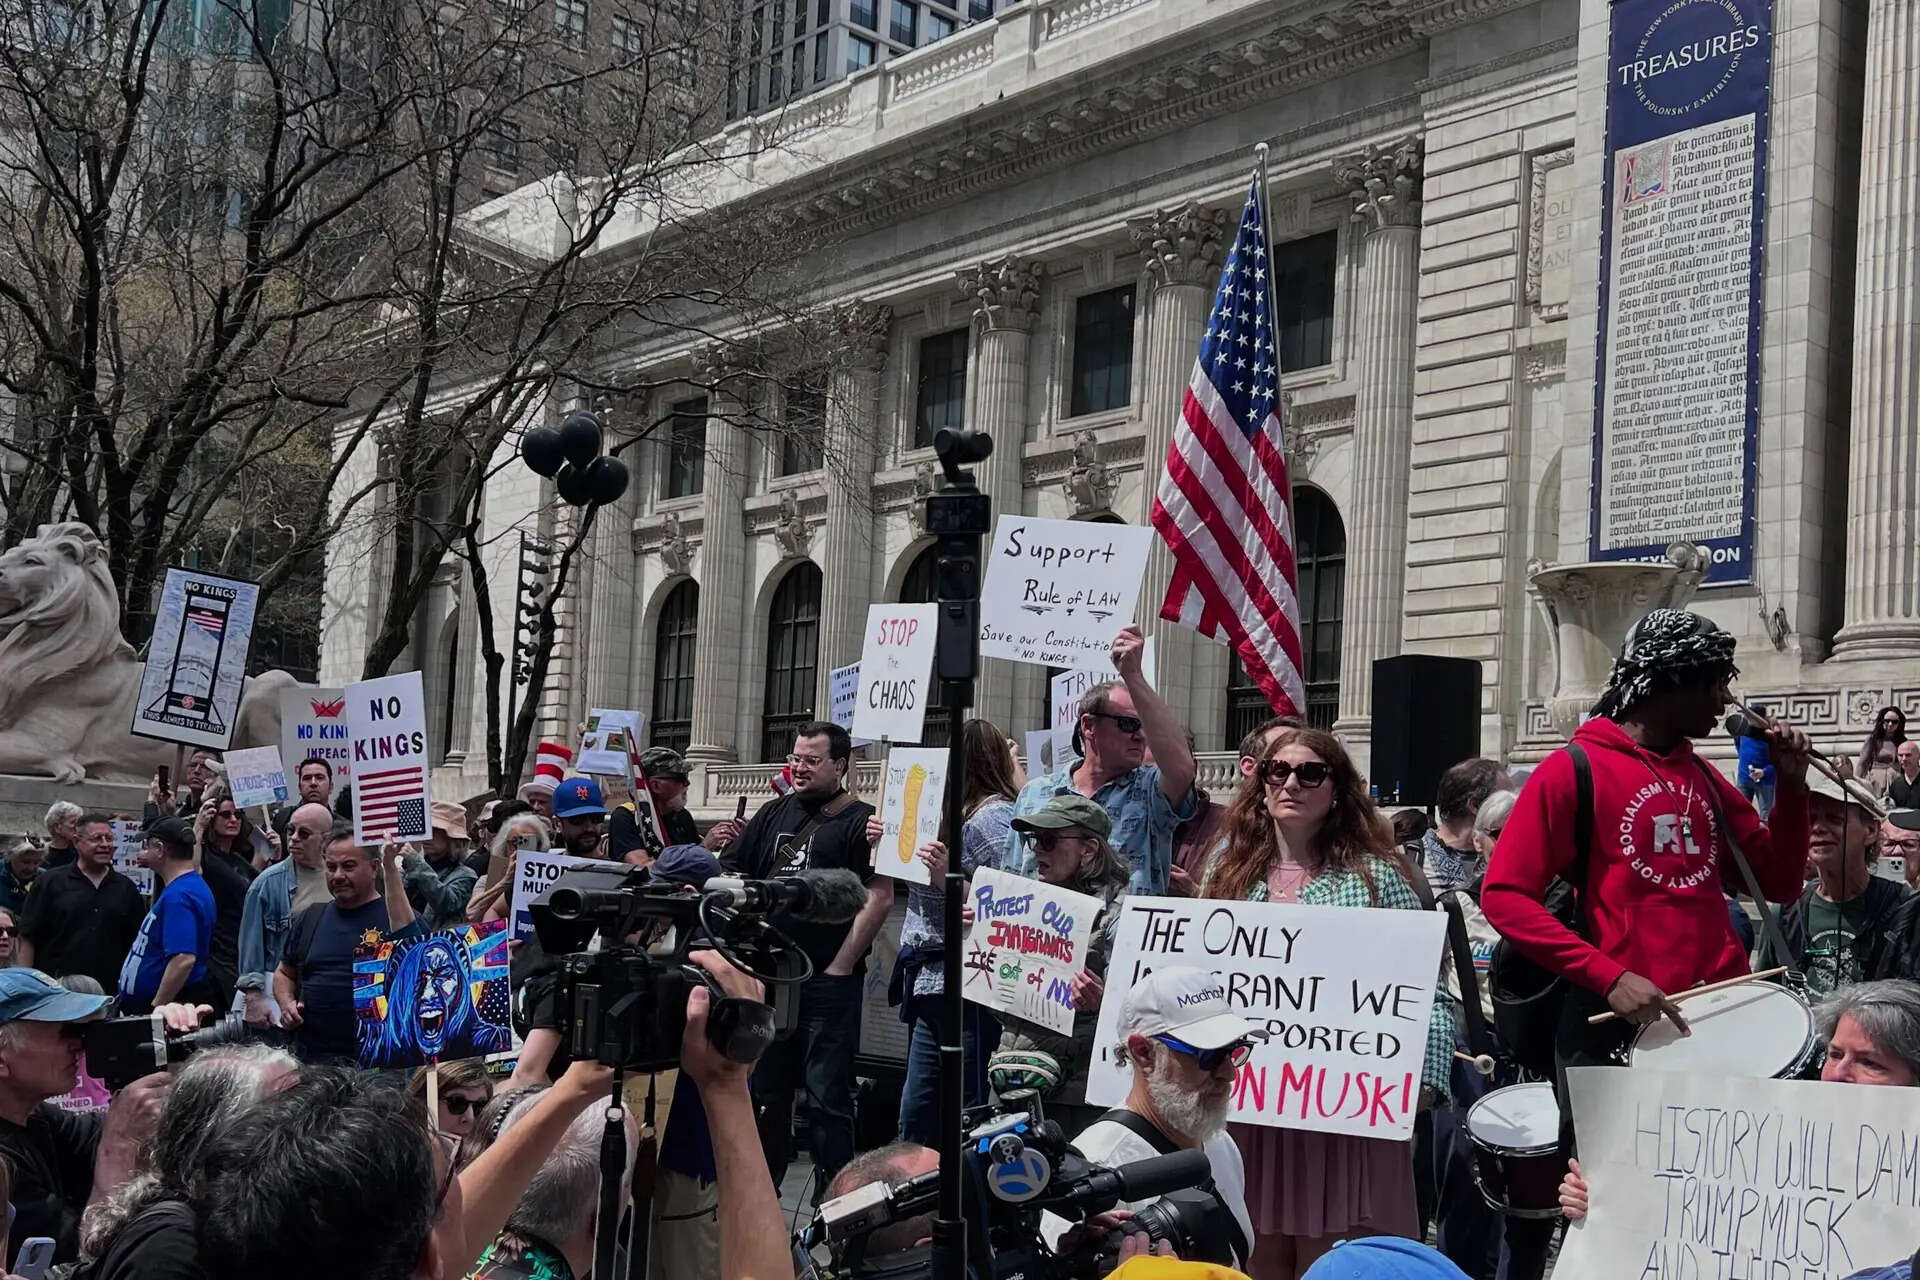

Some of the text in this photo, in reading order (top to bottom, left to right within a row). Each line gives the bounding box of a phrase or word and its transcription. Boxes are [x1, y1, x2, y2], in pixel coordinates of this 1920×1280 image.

[1645, 16, 1662, 38] NEW
[1662, 0, 1688, 19] YORK
[1719, 0, 1745, 27] LIBRARY
[1618, 25, 1759, 86] TREASURES
[1634, 52, 1744, 116] THE POLONSKY EXHIBITION
[1004, 526, 1115, 567] Support
[184, 581, 236, 598] NO KINGS
[1023, 578, 1121, 606] Rule of LAW
[877, 618, 918, 647] STOP
[981, 624, 1113, 651] Save our Constitutio
[888, 655, 899, 668] the
[1021, 650, 1067, 663] NO KINGS
[835, 691, 857, 704] REMOV
[869, 679, 916, 710] CHAOS
[1061, 671, 1121, 697] TRU
[370, 696, 401, 721] NO
[297, 724, 348, 739] NO KIN
[307, 748, 349, 761] IMPEAC
[354, 732, 423, 762] KINGS
[1620, 782, 1662, 857] SOCIALISM
[1631, 858, 1663, 884] FOR
[1668, 865, 1711, 889] PARTY
[975, 885, 1075, 939] PROTECT OUR
[1132, 906, 1303, 964] THE ONLY
[964, 950, 997, 973] ICE
[1027, 967, 1044, 992] of
[1352, 978, 1424, 1022] WE
[1277, 1062, 1412, 1130] MUSK!
[999, 1136, 1016, 1164] abc
[1635, 1102, 1920, 1207] HISTORY WILL DAM
[1654, 1174, 1853, 1272] TRUMP MUSK
